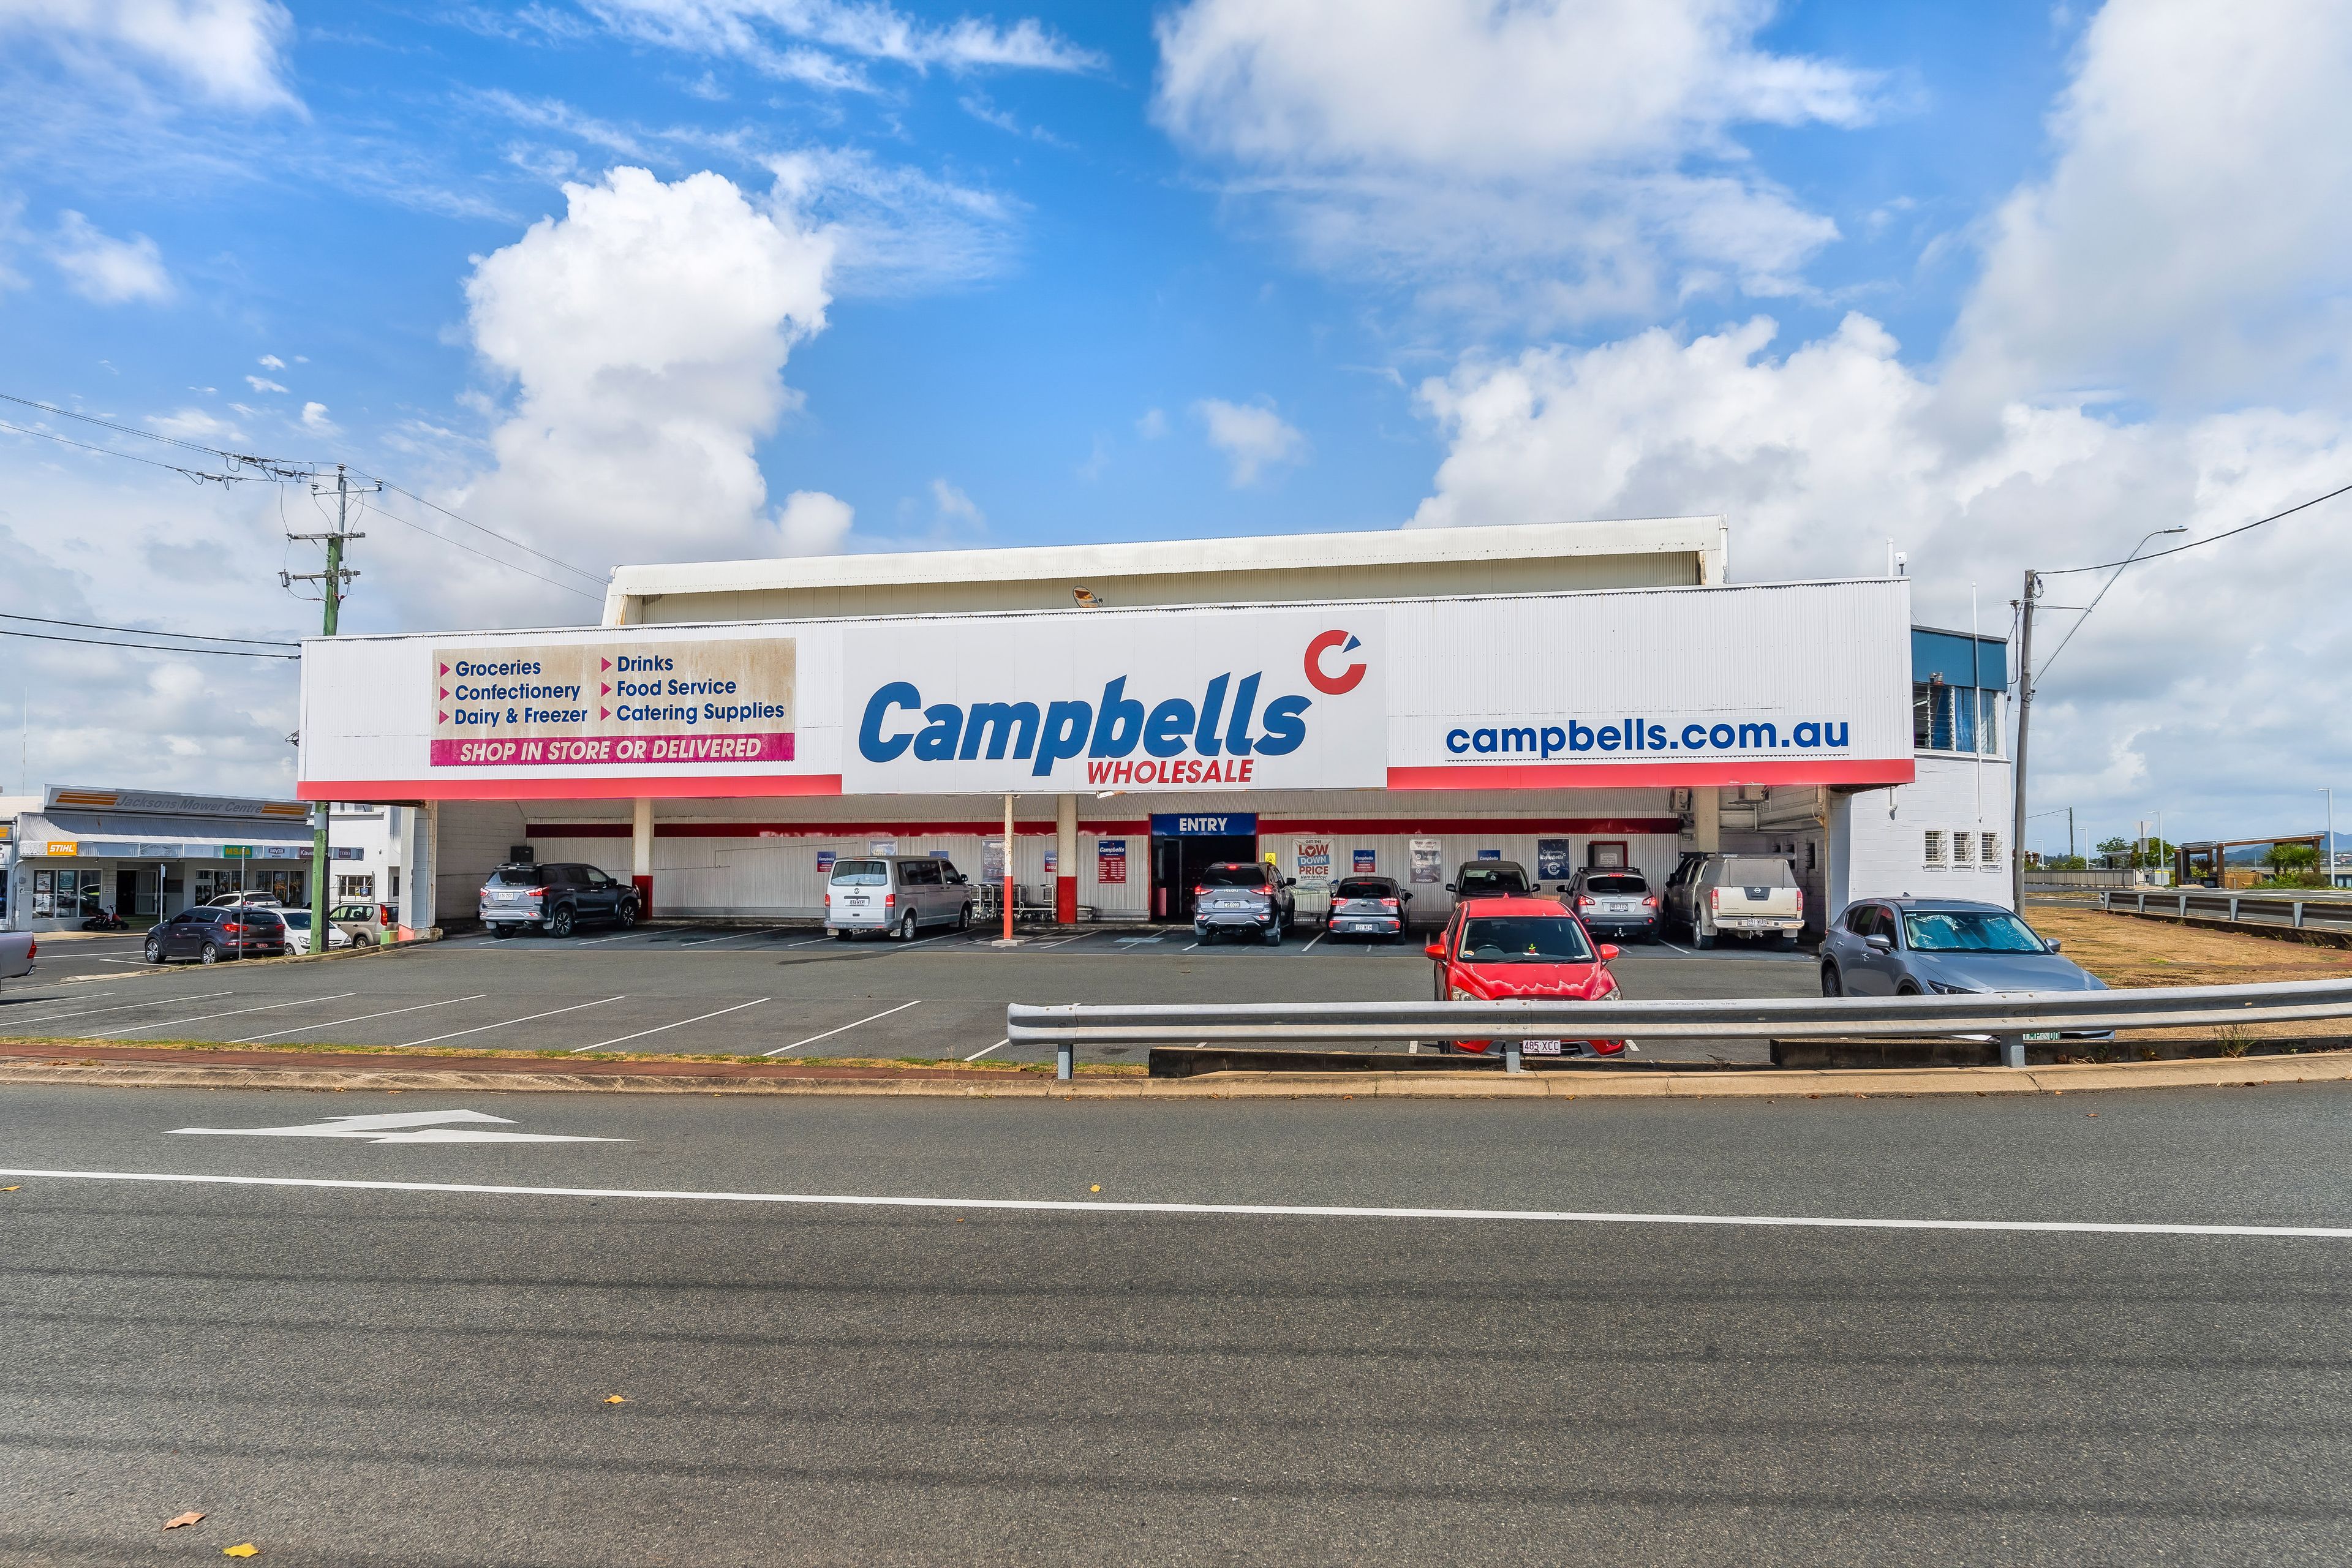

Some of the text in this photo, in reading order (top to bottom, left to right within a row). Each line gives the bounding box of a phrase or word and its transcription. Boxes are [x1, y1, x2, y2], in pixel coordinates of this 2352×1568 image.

[456, 660, 541, 676] Groceries
[617, 656, 673, 672] Drinks
[455, 683, 581, 702] Confectionery
[617, 679, 736, 696] Food Service
[454, 707, 588, 727] Dairy & Freezer
[616, 702, 785, 725] Catering Supplies
[859, 671, 1312, 776] Campbells
[1446, 718, 1849, 758] campbells.com.au
[460, 738, 762, 761] SHOP IN STORE OR DELIVERED
[1087, 759, 1254, 785] WHOLESALE
[116, 796, 262, 813] Jacksons Mower Centre
[1179, 818, 1227, 831] ENTRY
[1298, 845, 1329, 857] LOW
[1299, 866, 1329, 875] PRICE
